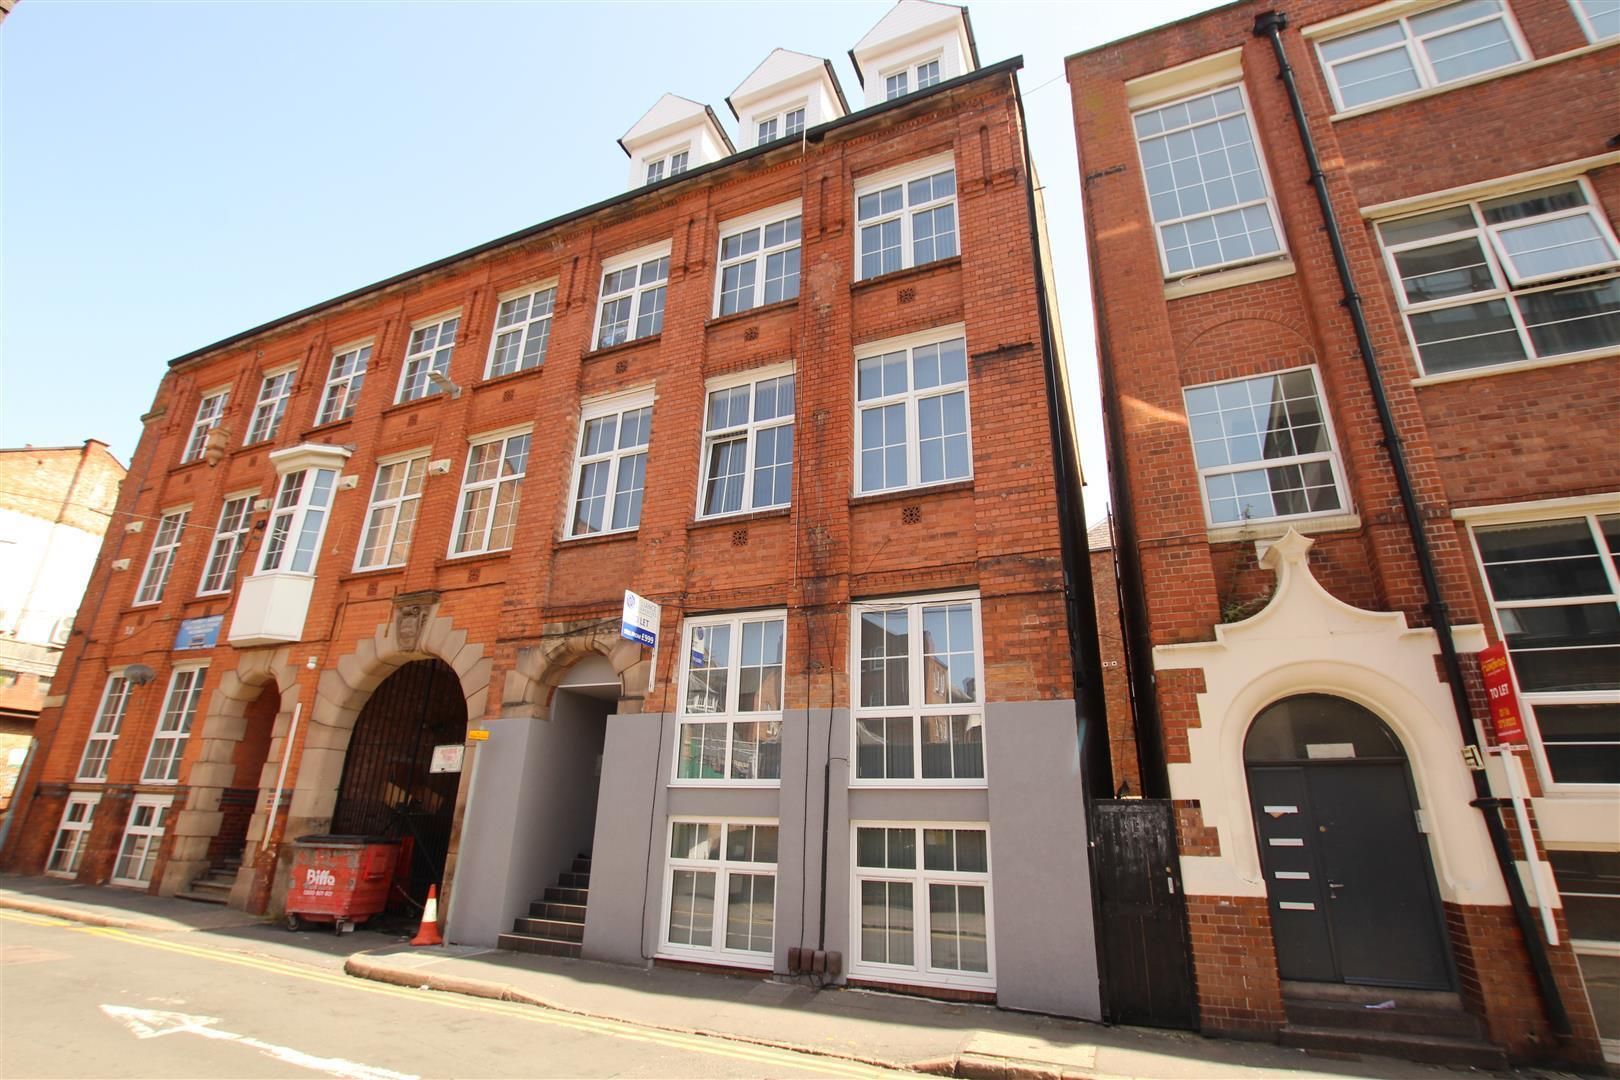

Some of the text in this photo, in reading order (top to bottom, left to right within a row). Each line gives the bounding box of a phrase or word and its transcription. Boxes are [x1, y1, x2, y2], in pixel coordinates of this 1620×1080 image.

[1490, 683, 1510, 700] TO LET
[306, 869, 336, 886] Biffa
